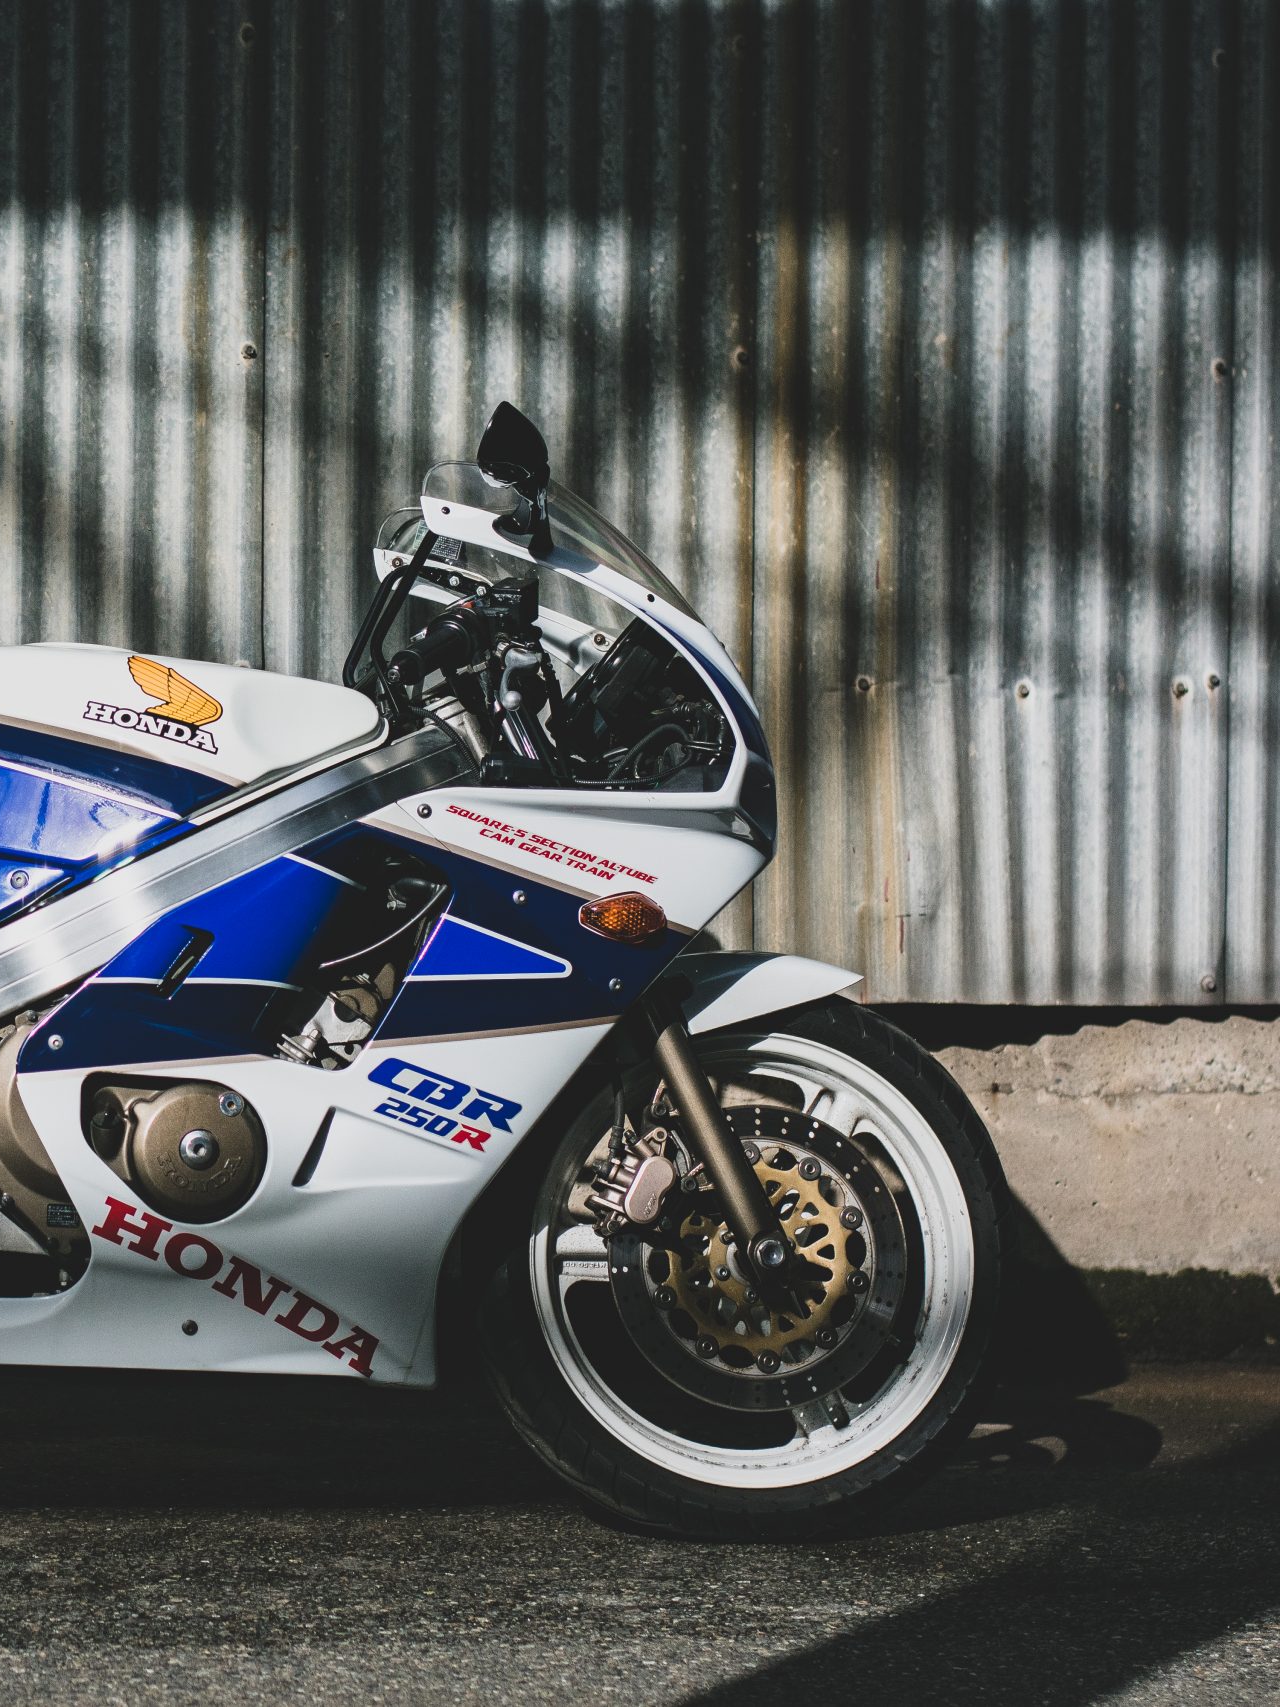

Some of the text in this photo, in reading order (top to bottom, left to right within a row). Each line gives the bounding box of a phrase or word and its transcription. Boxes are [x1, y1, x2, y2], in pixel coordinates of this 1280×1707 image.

[83, 700, 218, 755] HONDA
[479, 828, 616, 881] CAM GEAR TRAIN
[528, 834, 597, 863] SECTION
[367, 1057, 523, 1134] CBR
[373, 1097, 492, 1152] 250R
[156, 1150, 242, 1193] HONDA
[91, 1195, 380, 1378] HONDA
